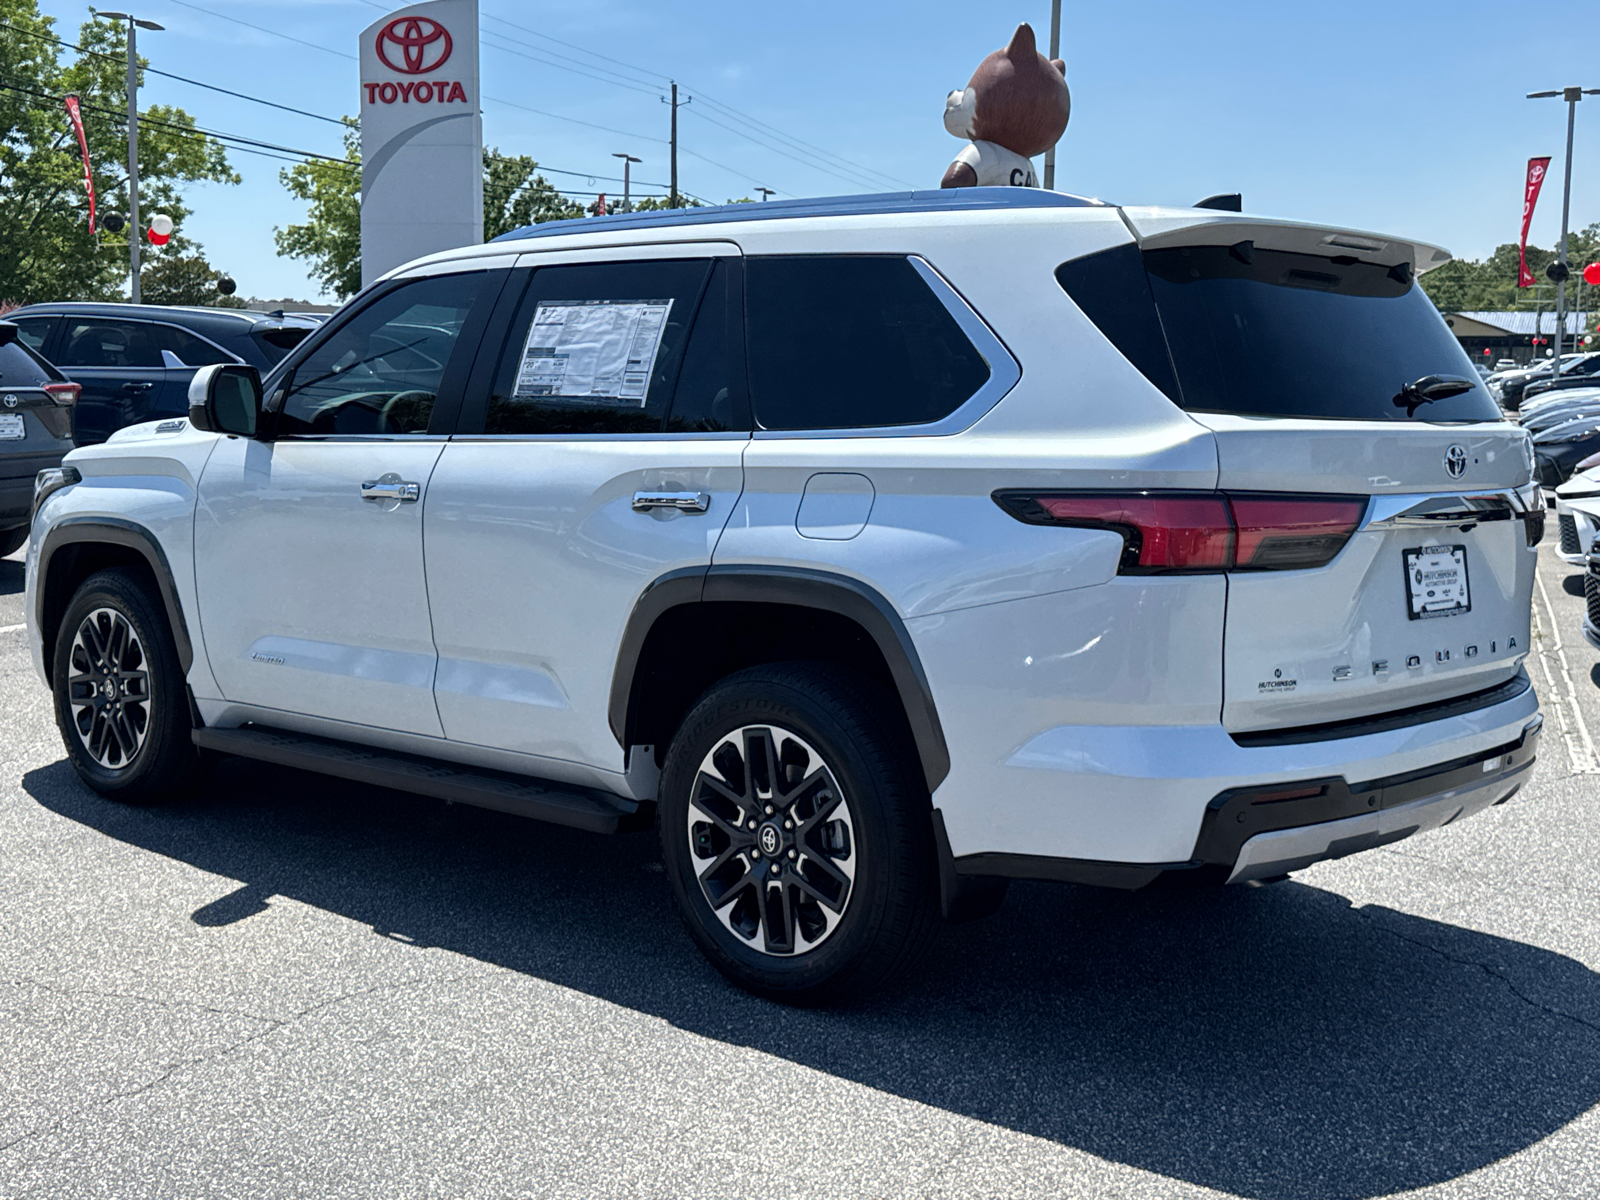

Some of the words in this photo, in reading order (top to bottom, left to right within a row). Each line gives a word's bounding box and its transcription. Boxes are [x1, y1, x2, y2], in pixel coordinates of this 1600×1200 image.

[363, 81, 467, 104] TOYOTA
[1332, 636, 1517, 682] SEQUOIA
[1258, 679, 1297, 688] HUTCHINSON
